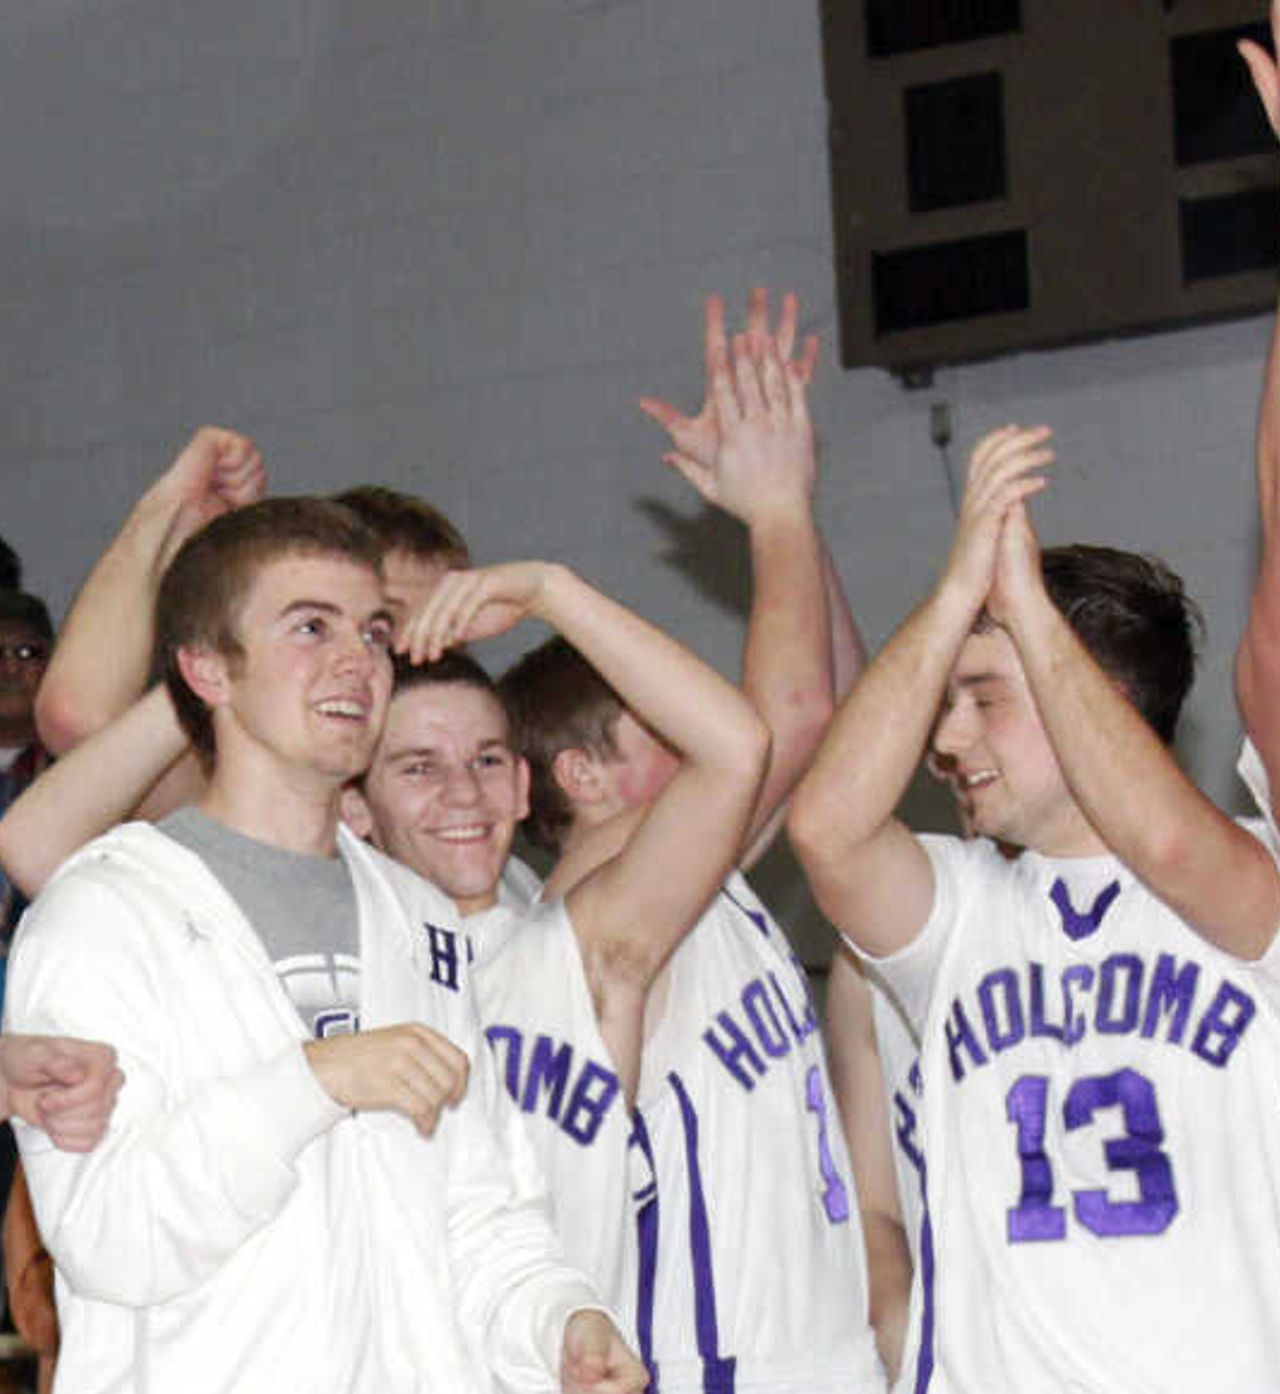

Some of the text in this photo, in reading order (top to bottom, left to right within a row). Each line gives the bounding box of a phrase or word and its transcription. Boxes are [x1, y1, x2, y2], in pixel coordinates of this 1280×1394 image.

[424, 922, 460, 992] H
[944, 952, 1256, 1084] HOLCOMB
[1004, 1066, 1180, 1243] 13
